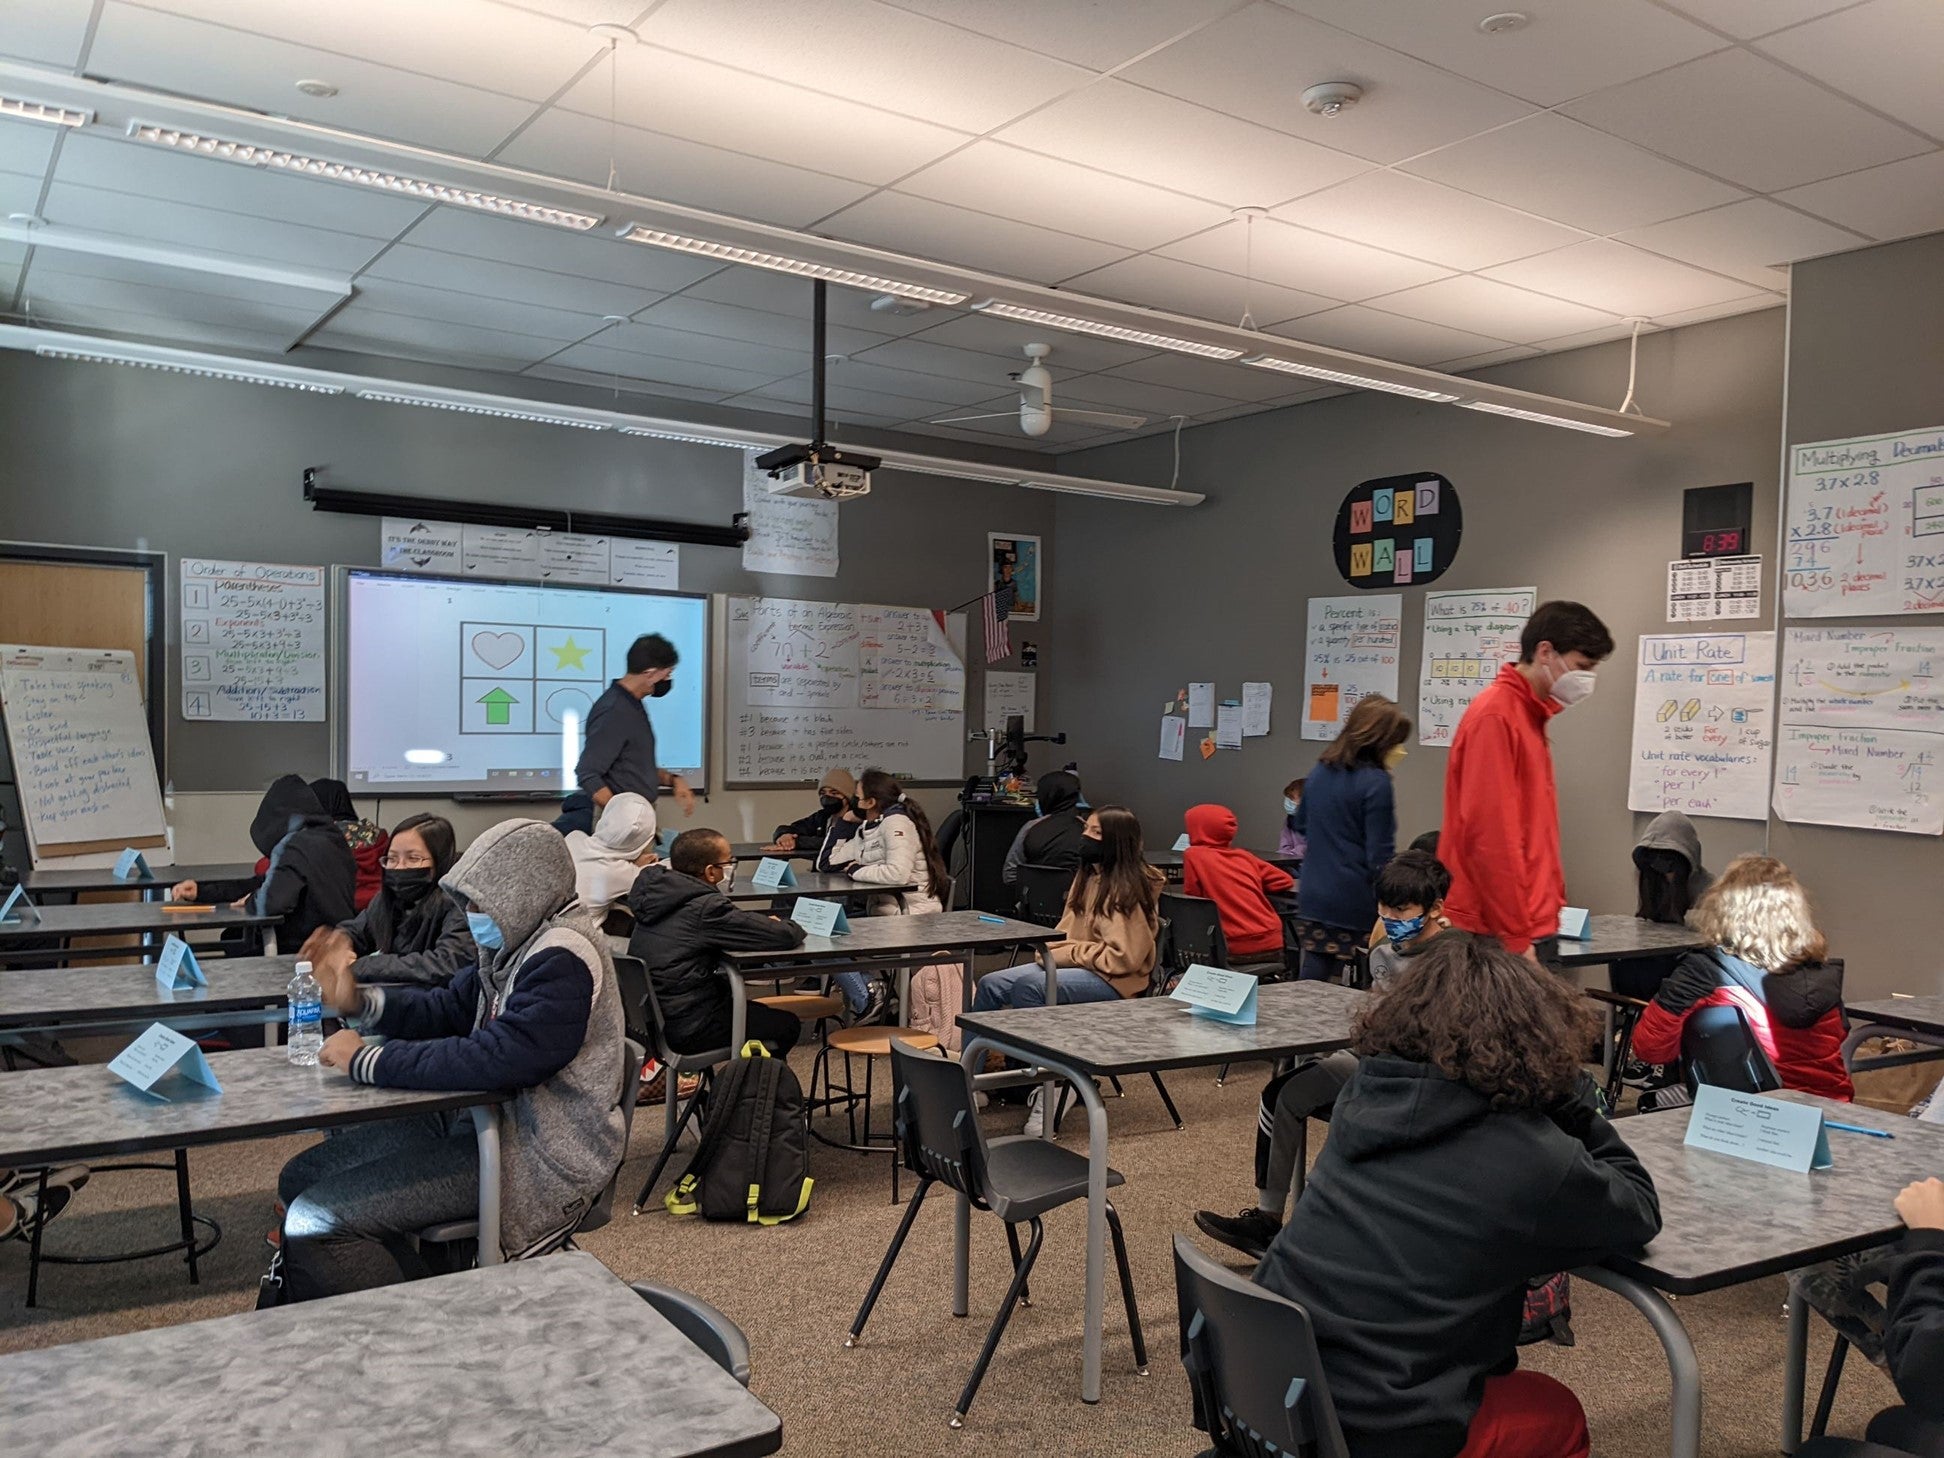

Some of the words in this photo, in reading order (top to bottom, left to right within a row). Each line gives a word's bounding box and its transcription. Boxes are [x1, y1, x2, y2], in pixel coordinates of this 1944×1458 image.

[1802, 448, 1880, 467] Multiplying
[1353, 489, 1436, 527] WORD
[1353, 546, 1430, 577] WALL
[192, 561, 226, 576] Order
[234, 565, 245, 577] of
[255, 566, 316, 581] Operations
[1324, 605, 1364, 620] Percent
[1431, 604, 1456, 616] What
[191, 623, 202, 638] 2
[1431, 624, 1452, 637] Using
[1486, 621, 1520, 635] diagram
[1793, 631, 1822, 643] Mixed
[1827, 631, 1866, 641] Number
[1653, 642, 1687, 661] Unit
[1696, 640, 1735, 660] Rate
[1845, 643, 1889, 657] Improper
[1895, 643, 1937, 654] Fraction
[1313, 653, 1331, 664] 25%
[191, 660, 201, 675] 3
[1644, 671, 1656, 683] A
[1660, 670, 1683, 682] rate
[1688, 669, 1706, 683] for
[1710, 672, 1731, 683] one
[1736, 671, 1747, 683] of
[20, 679, 47, 691] Take
[190, 696, 202, 714] 4
[1430, 696, 1454, 709] Using
[1703, 726, 1719, 735] For
[1746, 729, 1761, 739] cup
[1788, 729, 1831, 744] Improper
[1838, 731, 1878, 743] Fraction
[1702, 734, 1728, 747] every
[1750, 739, 1771, 750] sugar
[446, 752, 453, 761] 3
[1641, 750, 1665, 761] Unit
[1669, 751, 1691, 762] rate
[1831, 744, 1859, 757] Mixed
[1867, 748, 1905, 759] Number
[1680, 768, 1711, 782] every
